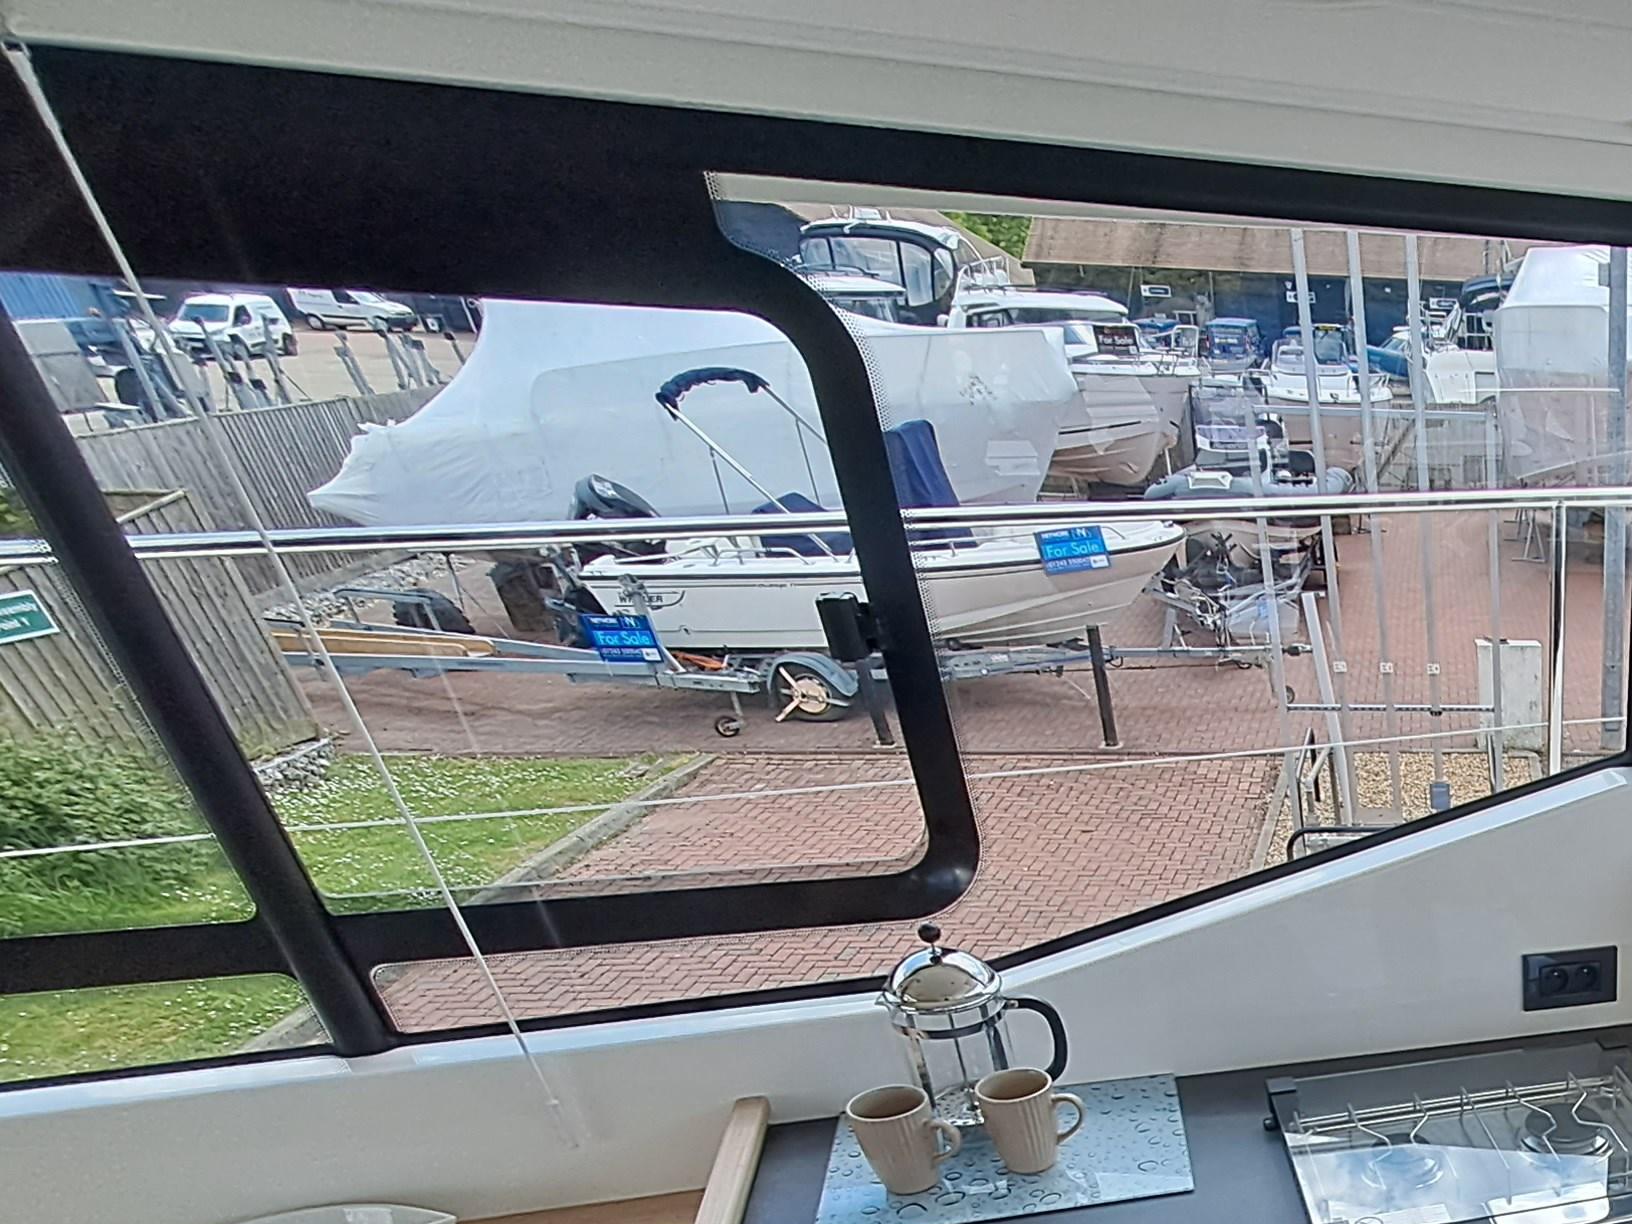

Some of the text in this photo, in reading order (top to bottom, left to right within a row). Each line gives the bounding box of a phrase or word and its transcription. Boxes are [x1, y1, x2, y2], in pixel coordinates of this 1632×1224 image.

[1045, 540, 1099, 558] For Sale
[598, 631, 650, 645] For Sale
